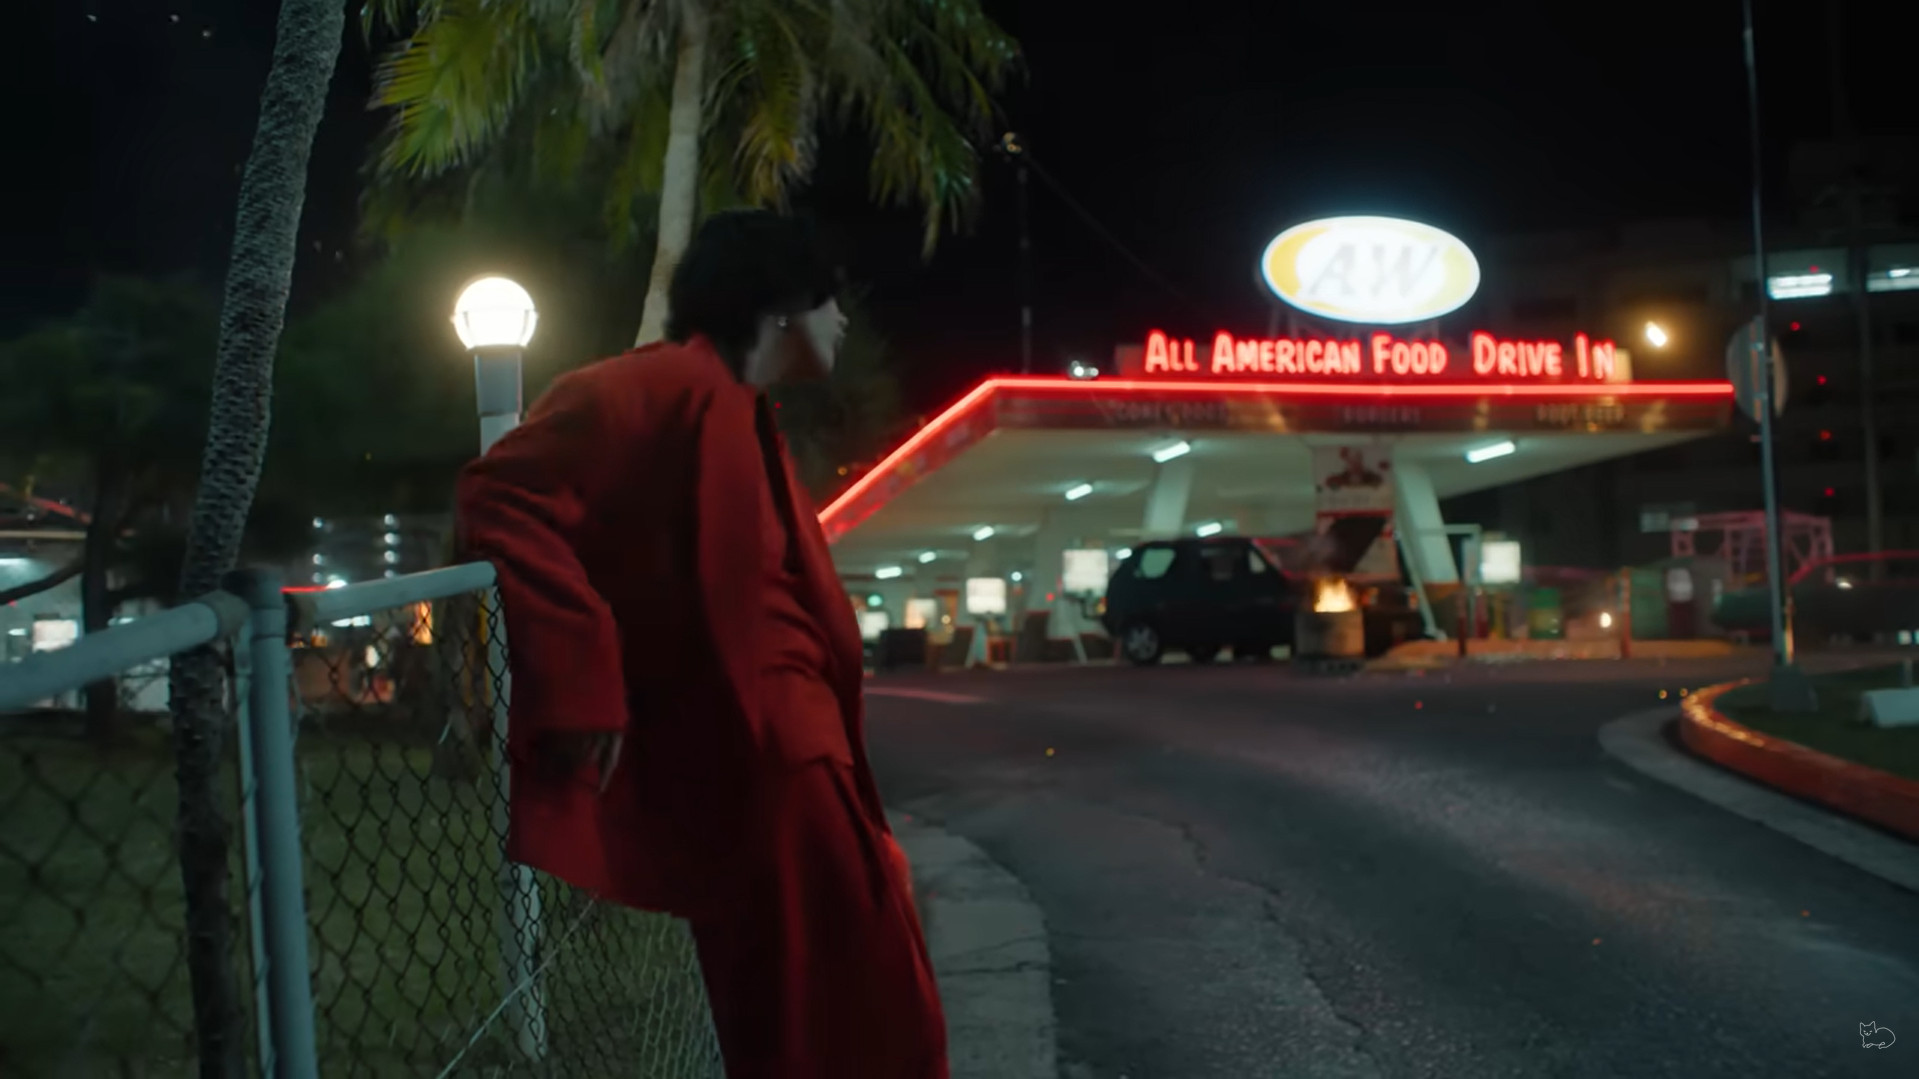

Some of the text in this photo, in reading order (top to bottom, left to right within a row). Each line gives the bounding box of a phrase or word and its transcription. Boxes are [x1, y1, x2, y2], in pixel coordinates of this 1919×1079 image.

[1145, 329, 1616, 380] ALL AMERICAN FOOD DRIVE IN
